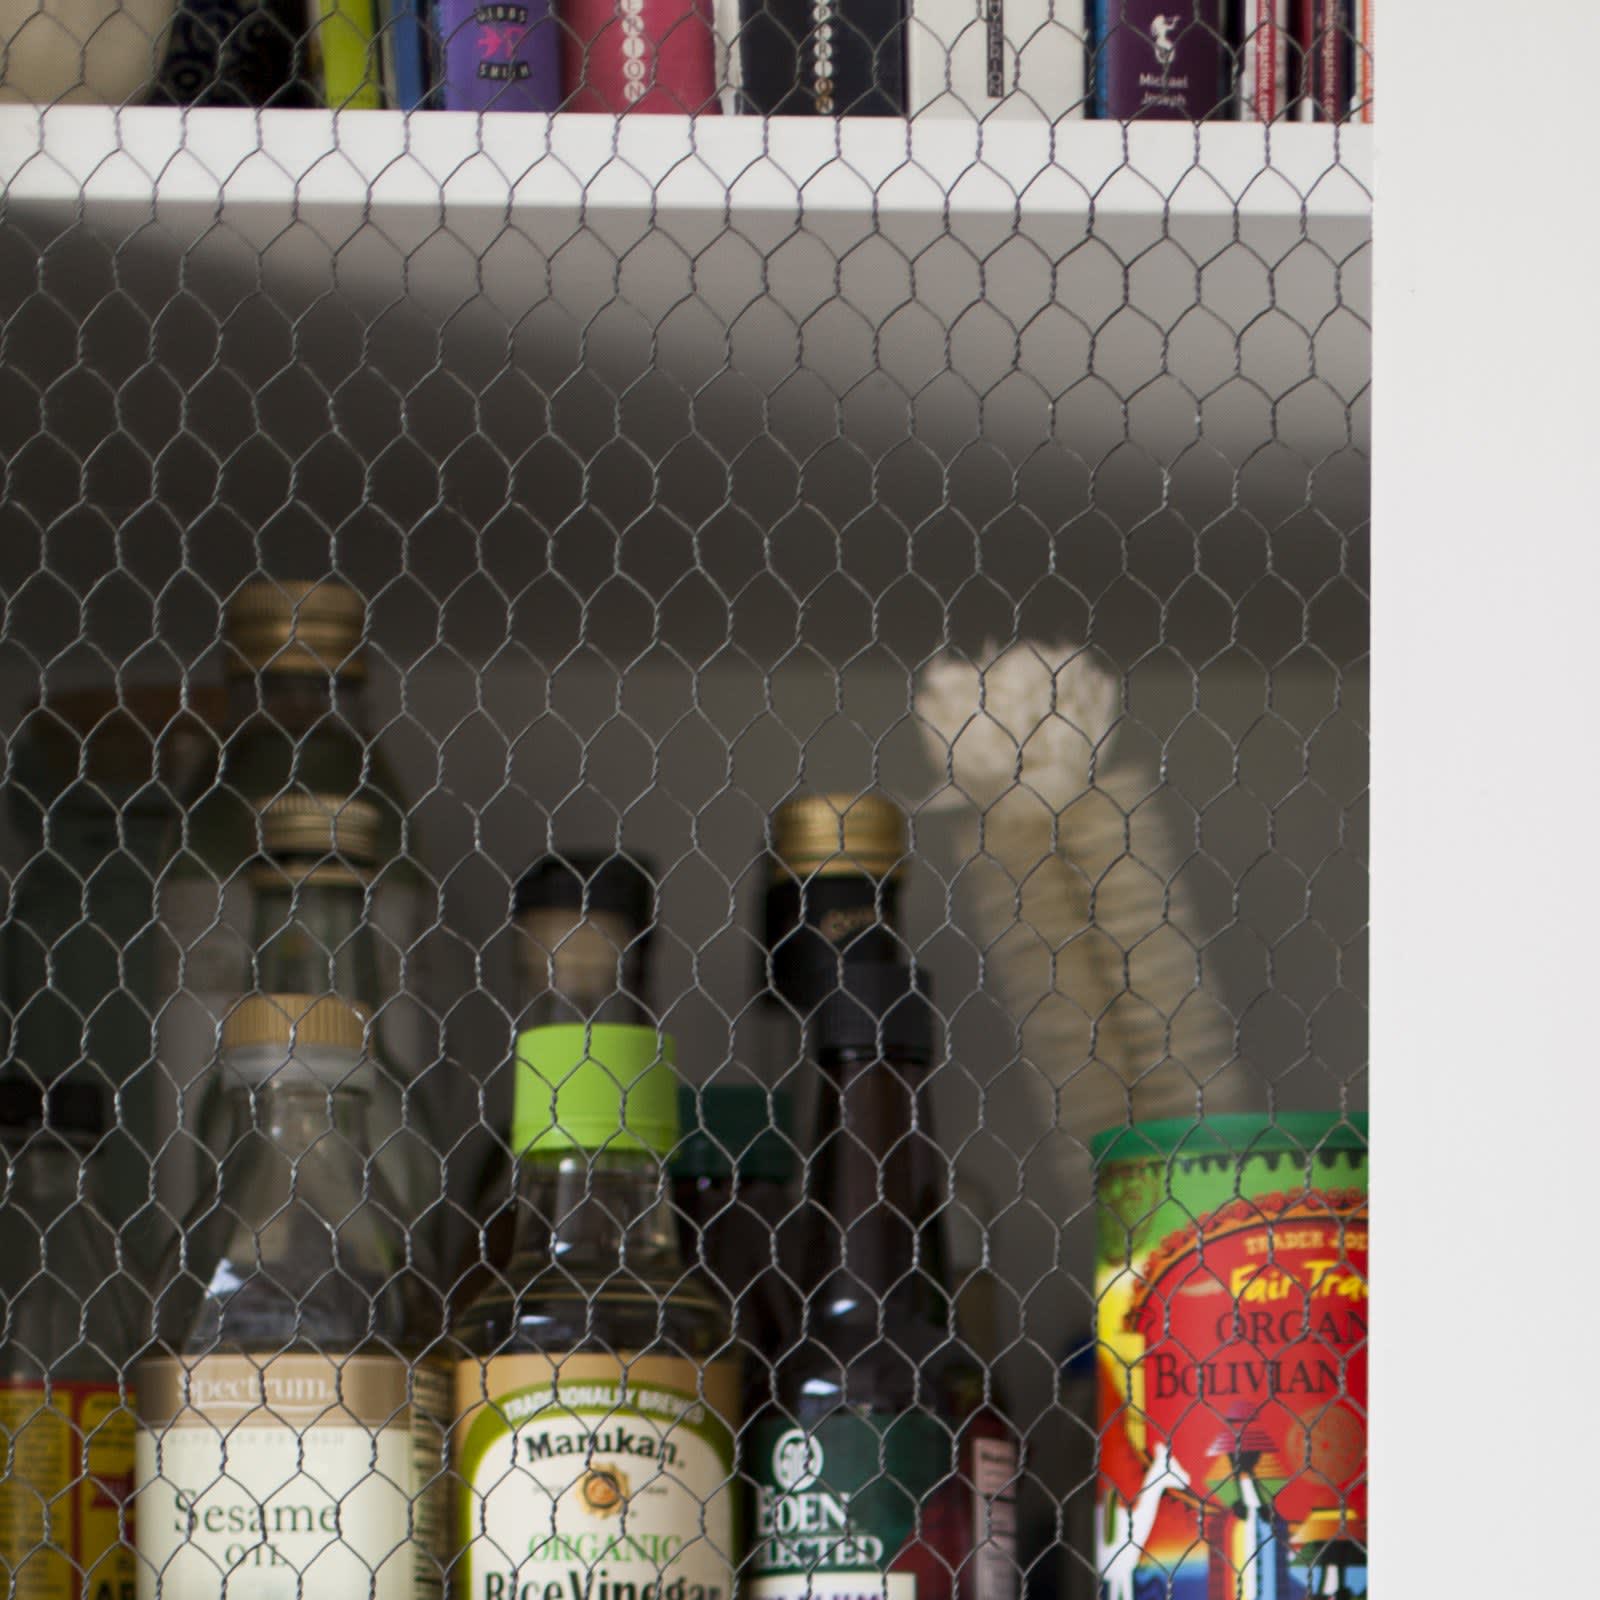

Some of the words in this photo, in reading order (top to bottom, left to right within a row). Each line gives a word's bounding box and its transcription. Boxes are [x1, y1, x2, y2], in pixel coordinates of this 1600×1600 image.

[1244, 1230, 1324, 1255] TRADER
[1230, 1263, 1295, 1304] Fair
[1303, 1259, 1368, 1302] Tra
[177, 1374, 327, 1404] Spectrum
[1155, 1352, 1341, 1399] BOLIVIAN
[524, 1427, 677, 1466] Marukan
[174, 1488, 340, 1534] Sesame
[757, 1486, 850, 1535] EDEN
[224, 1541, 288, 1568] OIL
[528, 1533, 682, 1564] ORGANIC
